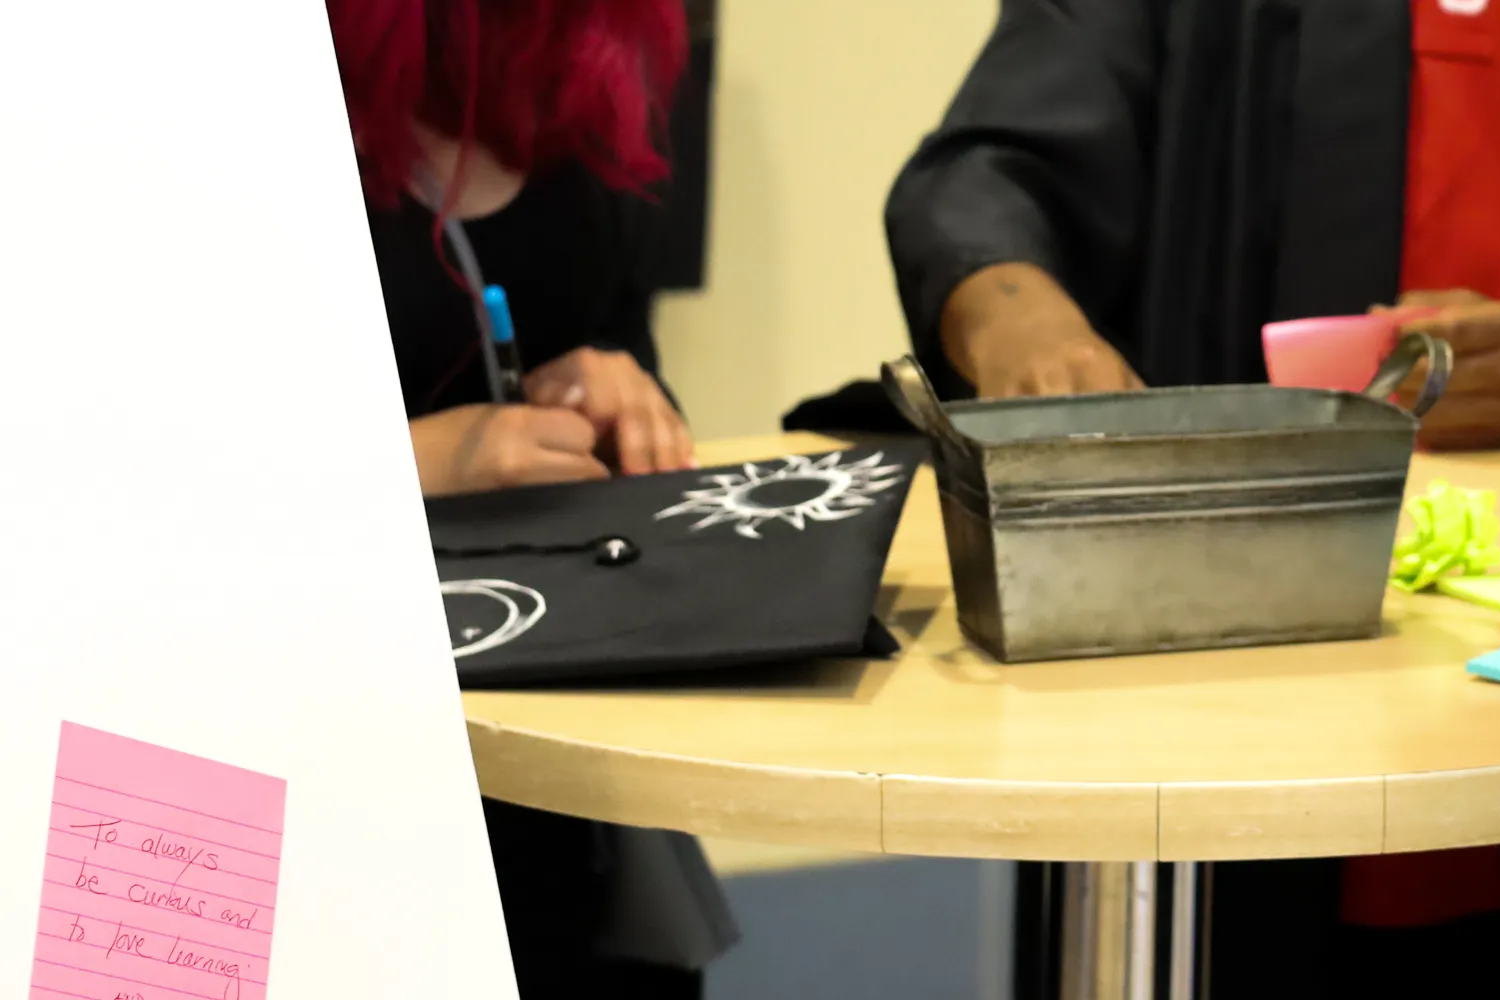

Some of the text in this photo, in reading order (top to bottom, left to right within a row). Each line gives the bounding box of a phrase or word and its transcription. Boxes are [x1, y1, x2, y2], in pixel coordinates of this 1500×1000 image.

[69, 819, 219, 893] To always
[75, 856, 108, 895] be
[220, 908, 258, 930] and
[68, 915, 85, 943] to
[106, 919, 153, 960] love
